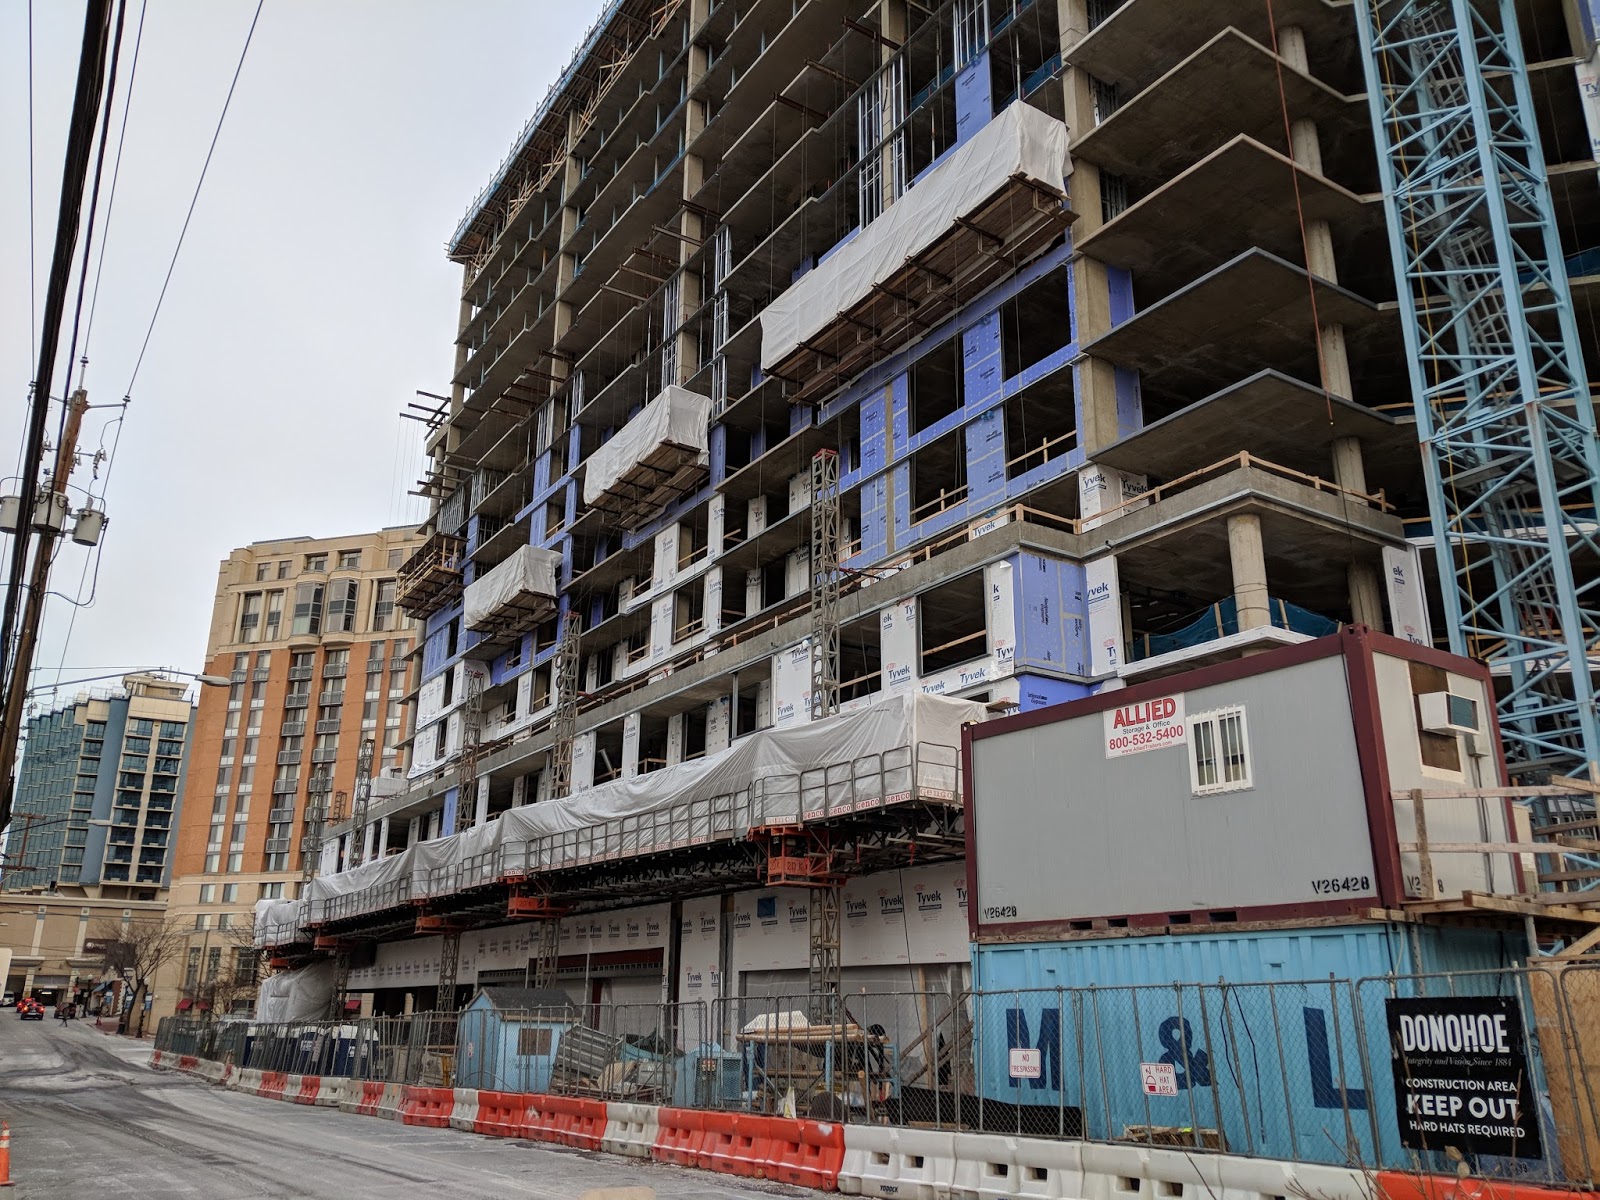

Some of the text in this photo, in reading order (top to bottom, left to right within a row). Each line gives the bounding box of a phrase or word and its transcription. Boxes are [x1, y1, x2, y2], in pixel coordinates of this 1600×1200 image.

[1122, 478, 1148, 493] Tyvek
[973, 521, 995, 537] Tyvek
[888, 665, 911, 680] Tyvek
[960, 667, 986, 684] Tyvek
[921, 680, 945, 694] Tyvek
[777, 703, 794, 716] Tyvek
[1114, 698, 1176, 729] ALLIED
[1123, 726, 1144, 735] Storage
[1153, 720, 1170, 729] Office
[1110, 725, 1183, 750] 800-532-5400
[1312, 876, 1370, 894] V26428
[880, 895, 903, 908] Tyvek
[917, 890, 941, 904] Tyvek
[788, 905, 807, 917] Tyvek
[846, 899, 867, 912] Tyvek
[984, 906, 1017, 919] V26428
[701, 917, 715, 927] Tyvek
[687, 972, 702, 982] Tyvek
[1400, 1014, 1510, 1053] DONOHOE
[1006, 1007, 1370, 1110] M & L
[1022, 1054, 1030, 1062] NO
[1405, 1056, 1433, 1067] ntegrity
[1434, 1057, 1448, 1065] and
[1473, 1057, 1492, 1066] Since
[1495, 1057, 1512, 1067] 1884
[1011, 1065, 1040, 1073] TRESPASSING
[1155, 1066, 1171, 1074] HARD
[1159, 1085, 1173, 1093] AREA
[1406, 1079, 1517, 1092] CONSTRUCTION AREA
[1406, 1094, 1519, 1120] KEEP OUT
[1410, 1120, 1525, 1138] HARD HATS REQUIRED
